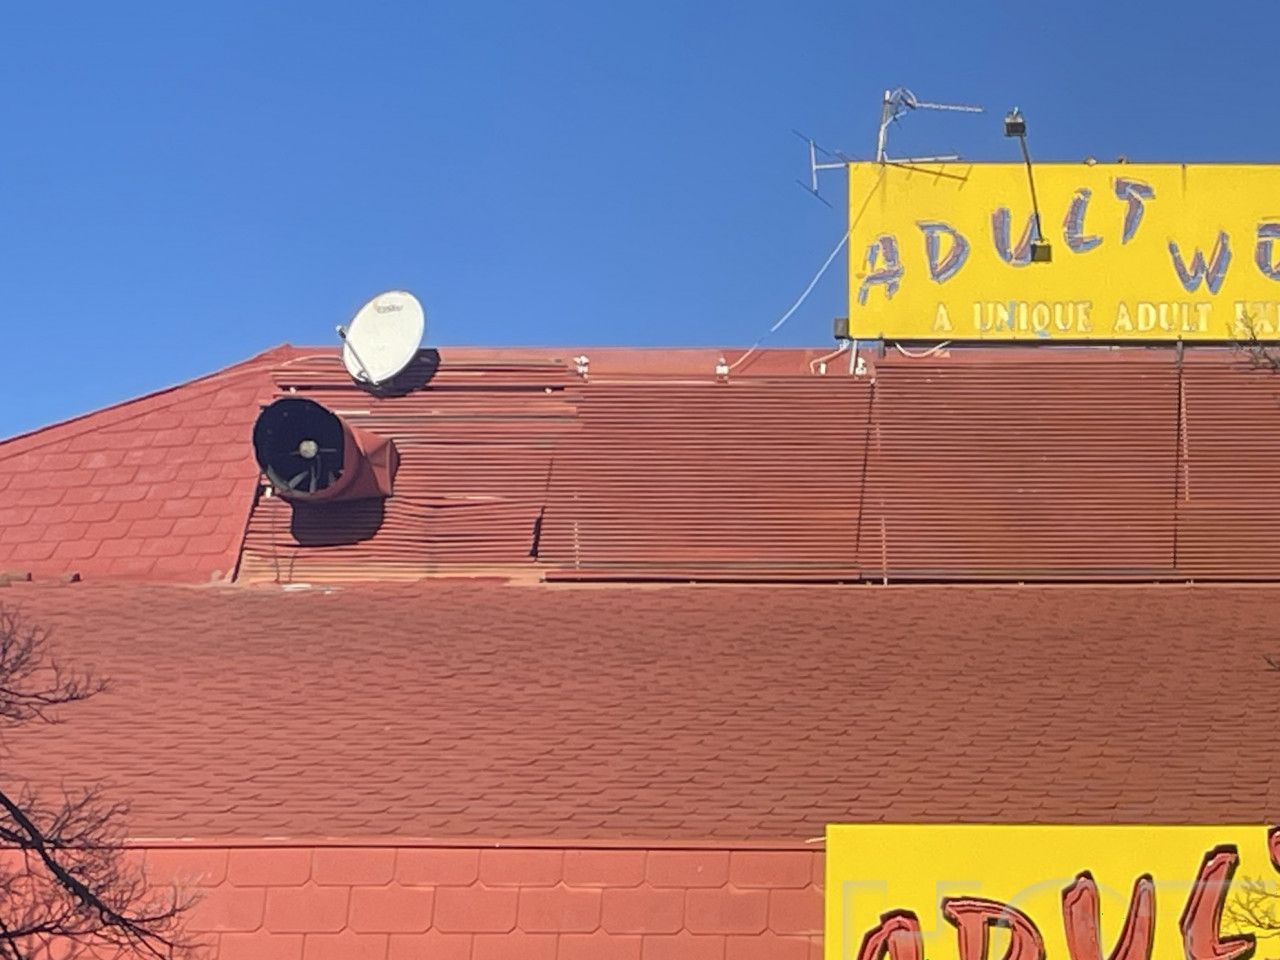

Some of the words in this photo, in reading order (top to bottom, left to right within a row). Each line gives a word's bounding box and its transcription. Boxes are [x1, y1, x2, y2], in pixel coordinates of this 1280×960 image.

[857, 175, 1156, 305] ADULT
[932, 302, 953, 332] A
[973, 301, 1093, 337] UNIQUE
[1112, 301, 1214, 333] ADULT
